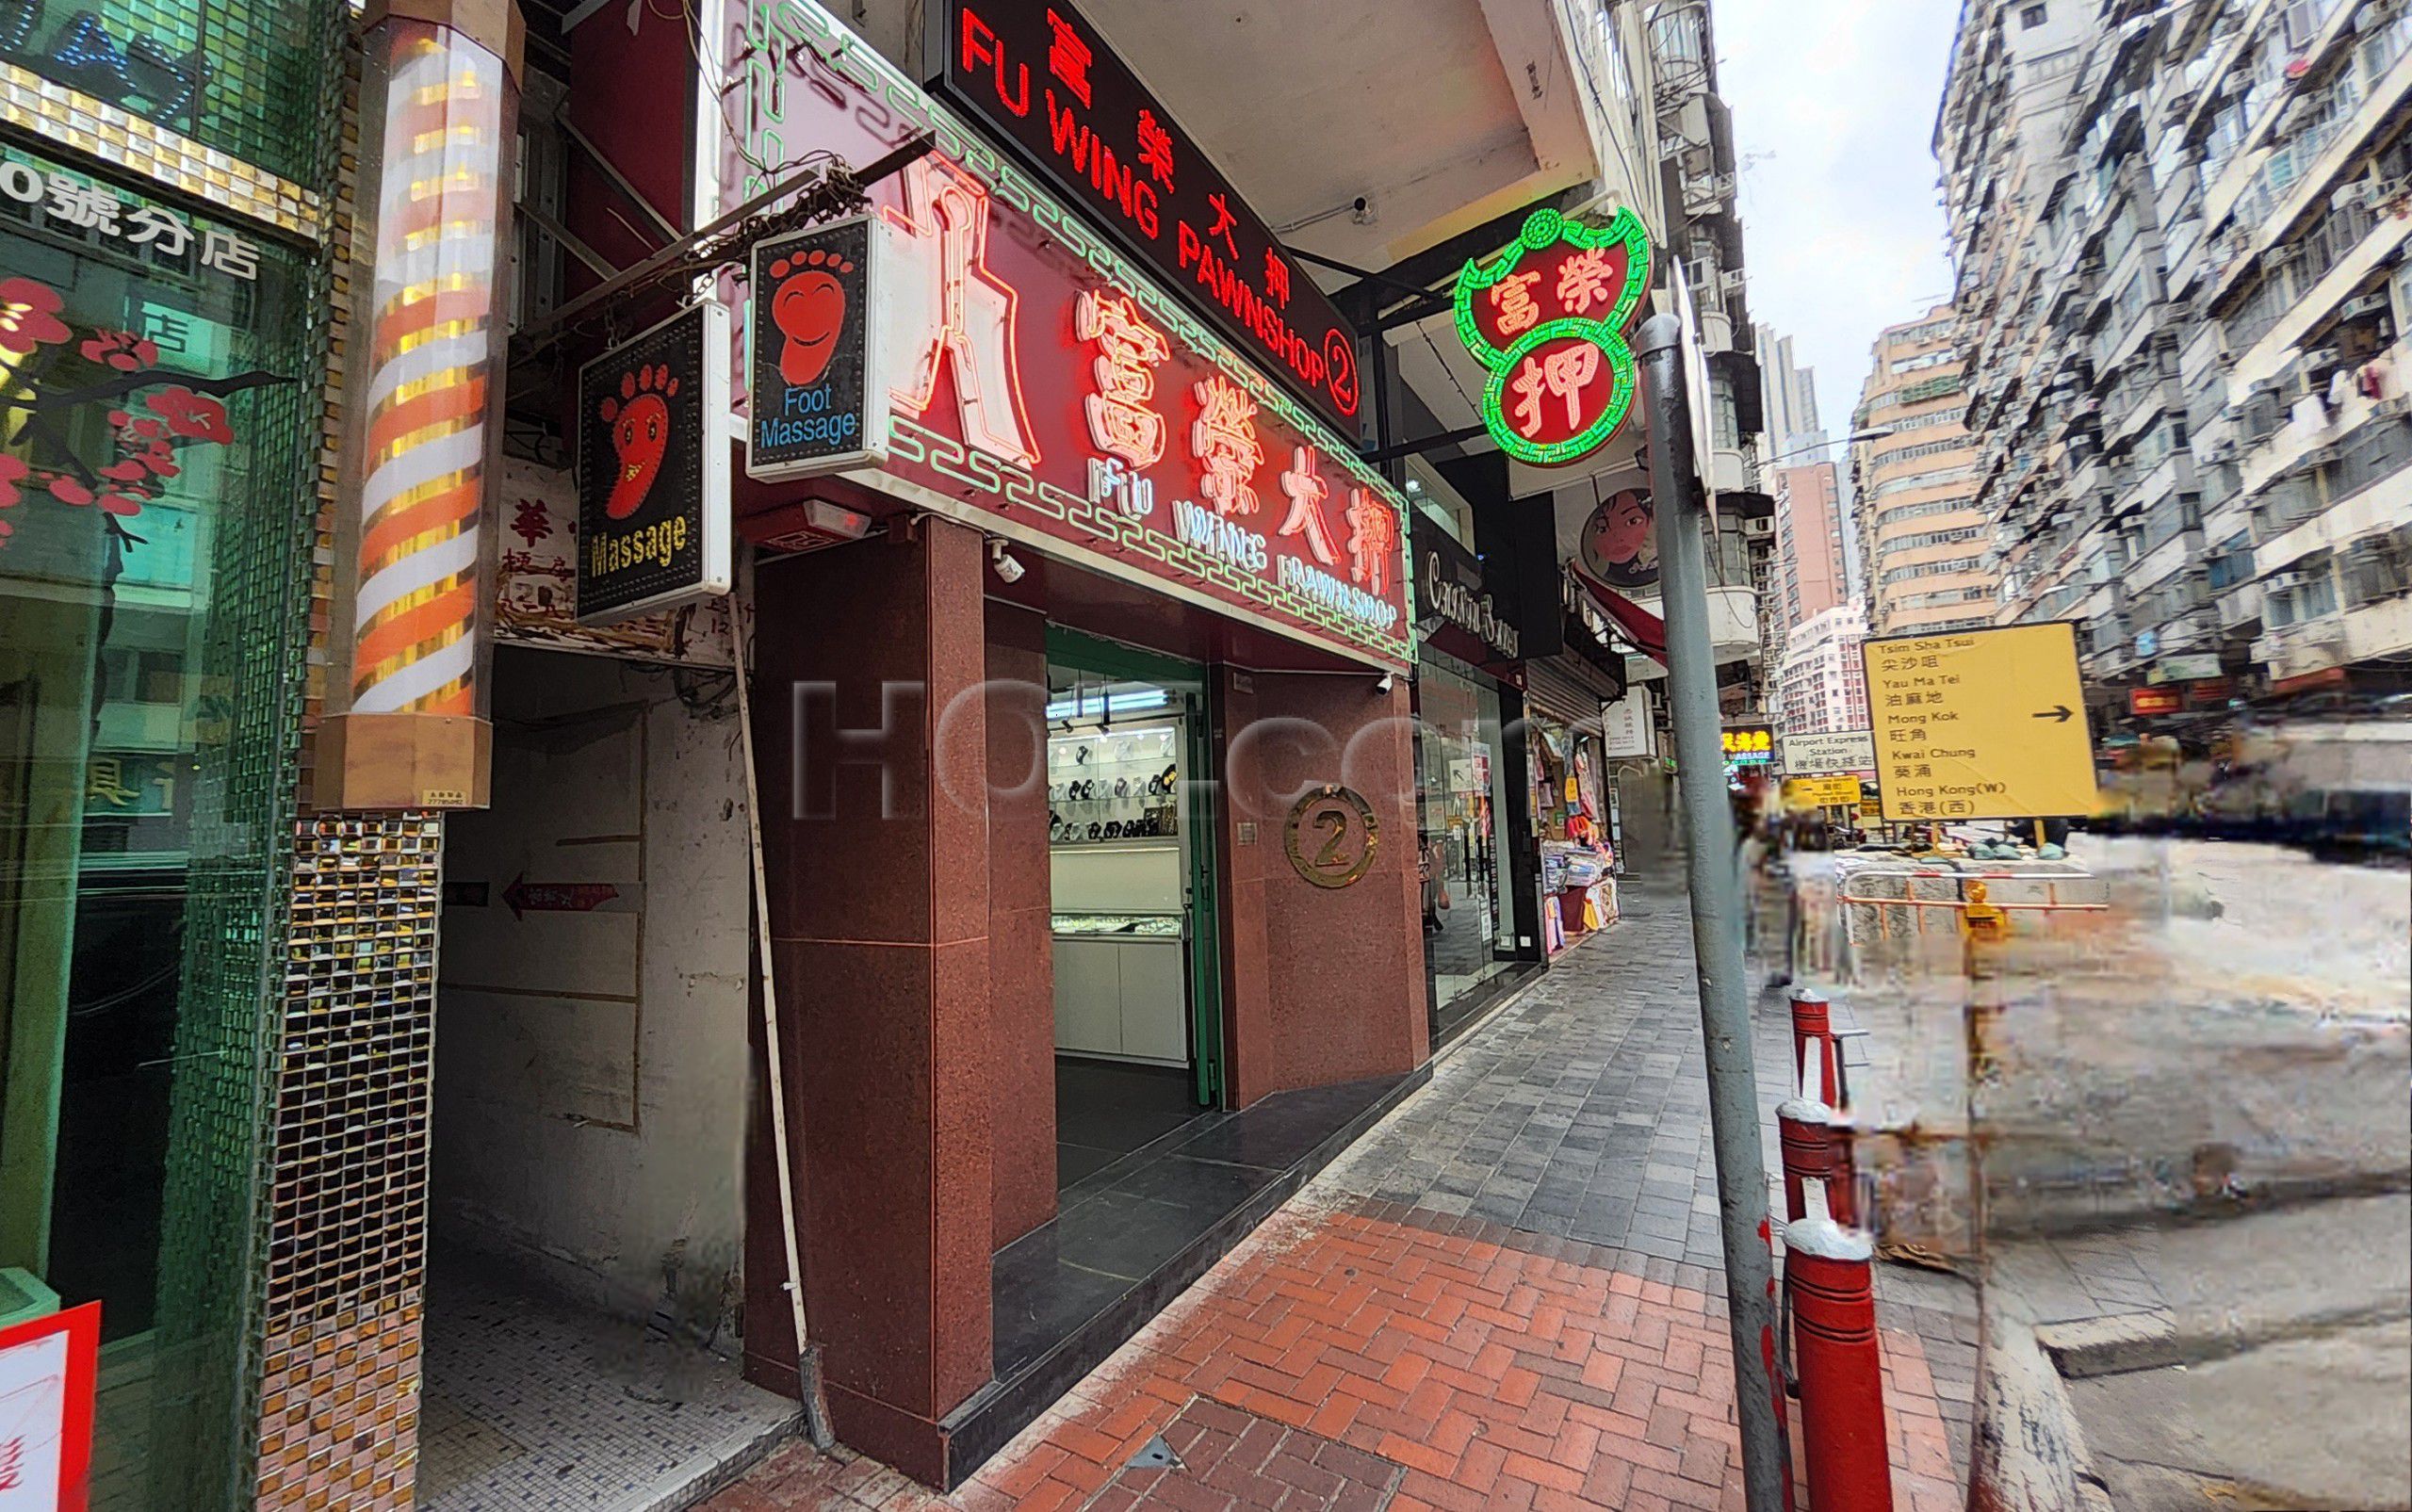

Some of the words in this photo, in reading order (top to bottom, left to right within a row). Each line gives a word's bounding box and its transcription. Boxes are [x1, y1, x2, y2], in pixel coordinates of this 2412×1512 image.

[962, 8, 1029, 117] FU
[1046, 89, 1159, 240] WING
[1179, 219, 1325, 388] PAWNSHOP
[1512, 342, 1599, 438] 押
[783, 383, 832, 416] Foot
[760, 410, 856, 449] Massage
[1089, 457, 1153, 521] FU
[1172, 499, 1268, 572] WING
[591, 515, 688, 577] Massage
[1878, 643, 1910, 654] Tsim
[1915, 641, 1941, 651] Sha
[1945, 638, 1975, 648] Tsui
[1881, 655, 1939, 672] 尖沙咀
[1882, 679, 1909, 689] Yau
[1914, 677, 1935, 686] Ma
[1939, 675, 1960, 685] Tei
[1885, 691, 1944, 707] 油麻地
[1887, 714, 1927, 724] Mong
[1931, 711, 1959, 722] Kok
[1788, 738, 1824, 748] Airport
[1827, 735, 1869, 746] Express
[1889, 728, 1927, 742] 旺角
[1809, 747, 1848, 756] Station
[1892, 750, 1925, 760] Kwai
[1930, 748, 1976, 759] Chung
[1896, 787, 1933, 798] Hong
[1939, 781, 2006, 797] Kong(W)
